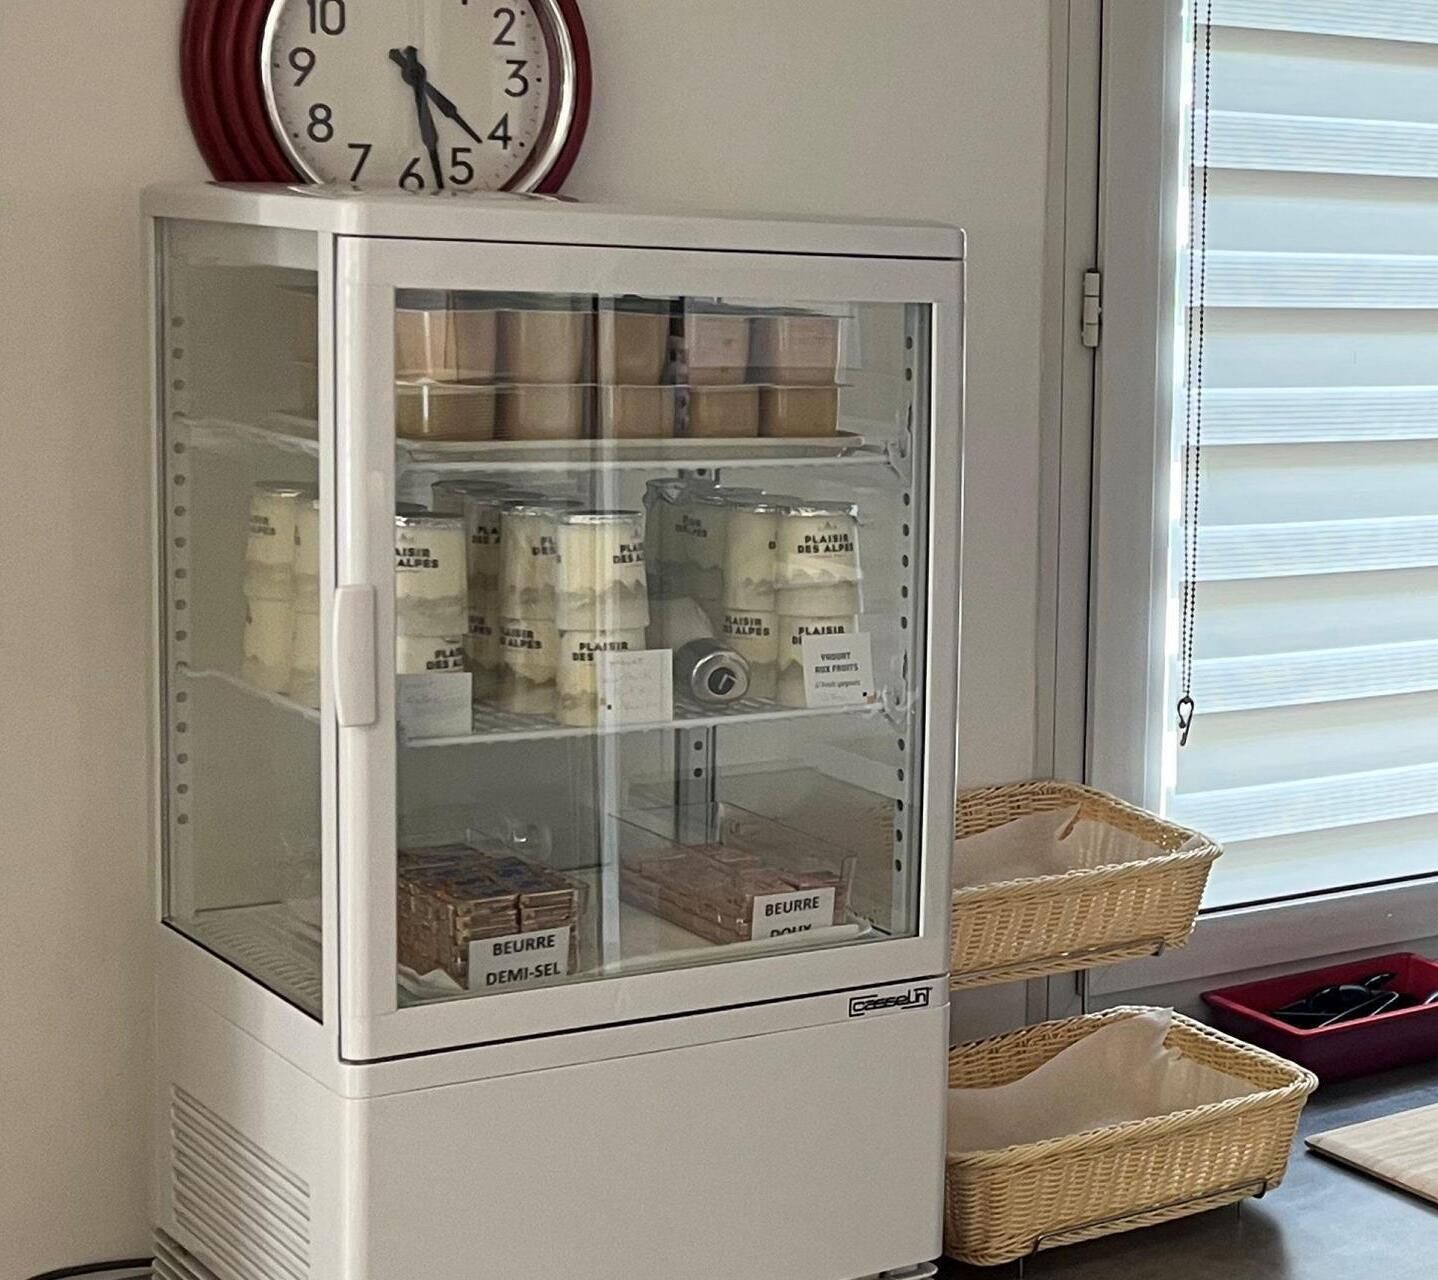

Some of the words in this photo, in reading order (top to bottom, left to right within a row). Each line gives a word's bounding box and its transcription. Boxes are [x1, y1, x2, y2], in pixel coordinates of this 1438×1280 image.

[493, 7, 516, 45] 2
[288, 47, 316, 86] 9
[504, 59, 529, 97] 3
[306, 103, 334, 142] 8
[487, 113, 512, 149] 4
[347, 143, 372, 181] 7
[448, 148, 475, 185] 5
[797, 545, 820, 554] DES
[397, 558, 439, 569] ALPES
[735, 627, 770, 636] ALPES
[798, 625, 846, 636] PLAISIR
[572, 652, 594, 662] DES
[579, 641, 628, 652] PLAISIR
[766, 896, 819, 917] BEURRE
[493, 934, 556, 957] BEURRE
[486, 962, 561, 986] DEMI-SEL
